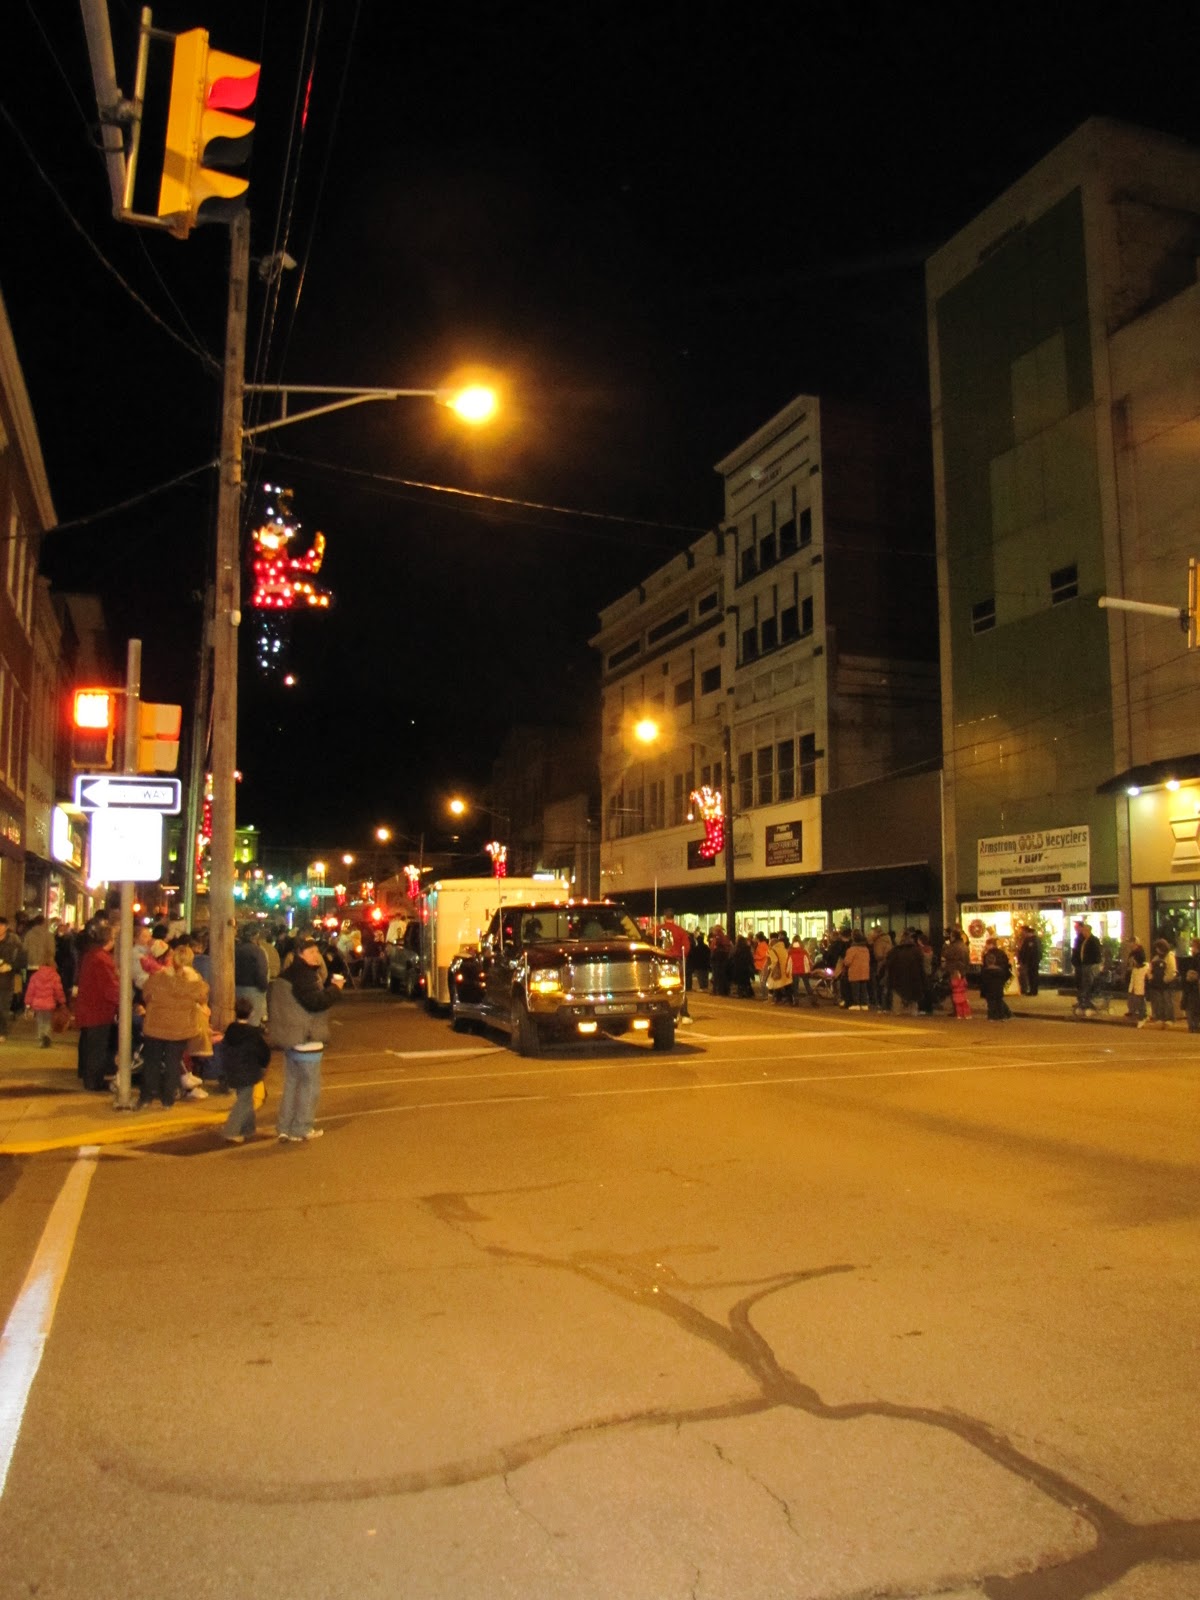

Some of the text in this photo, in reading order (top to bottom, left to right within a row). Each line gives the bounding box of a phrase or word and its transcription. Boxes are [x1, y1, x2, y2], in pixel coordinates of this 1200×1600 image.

[980, 830, 1087, 854] Armstrong GOLD Recyclers
